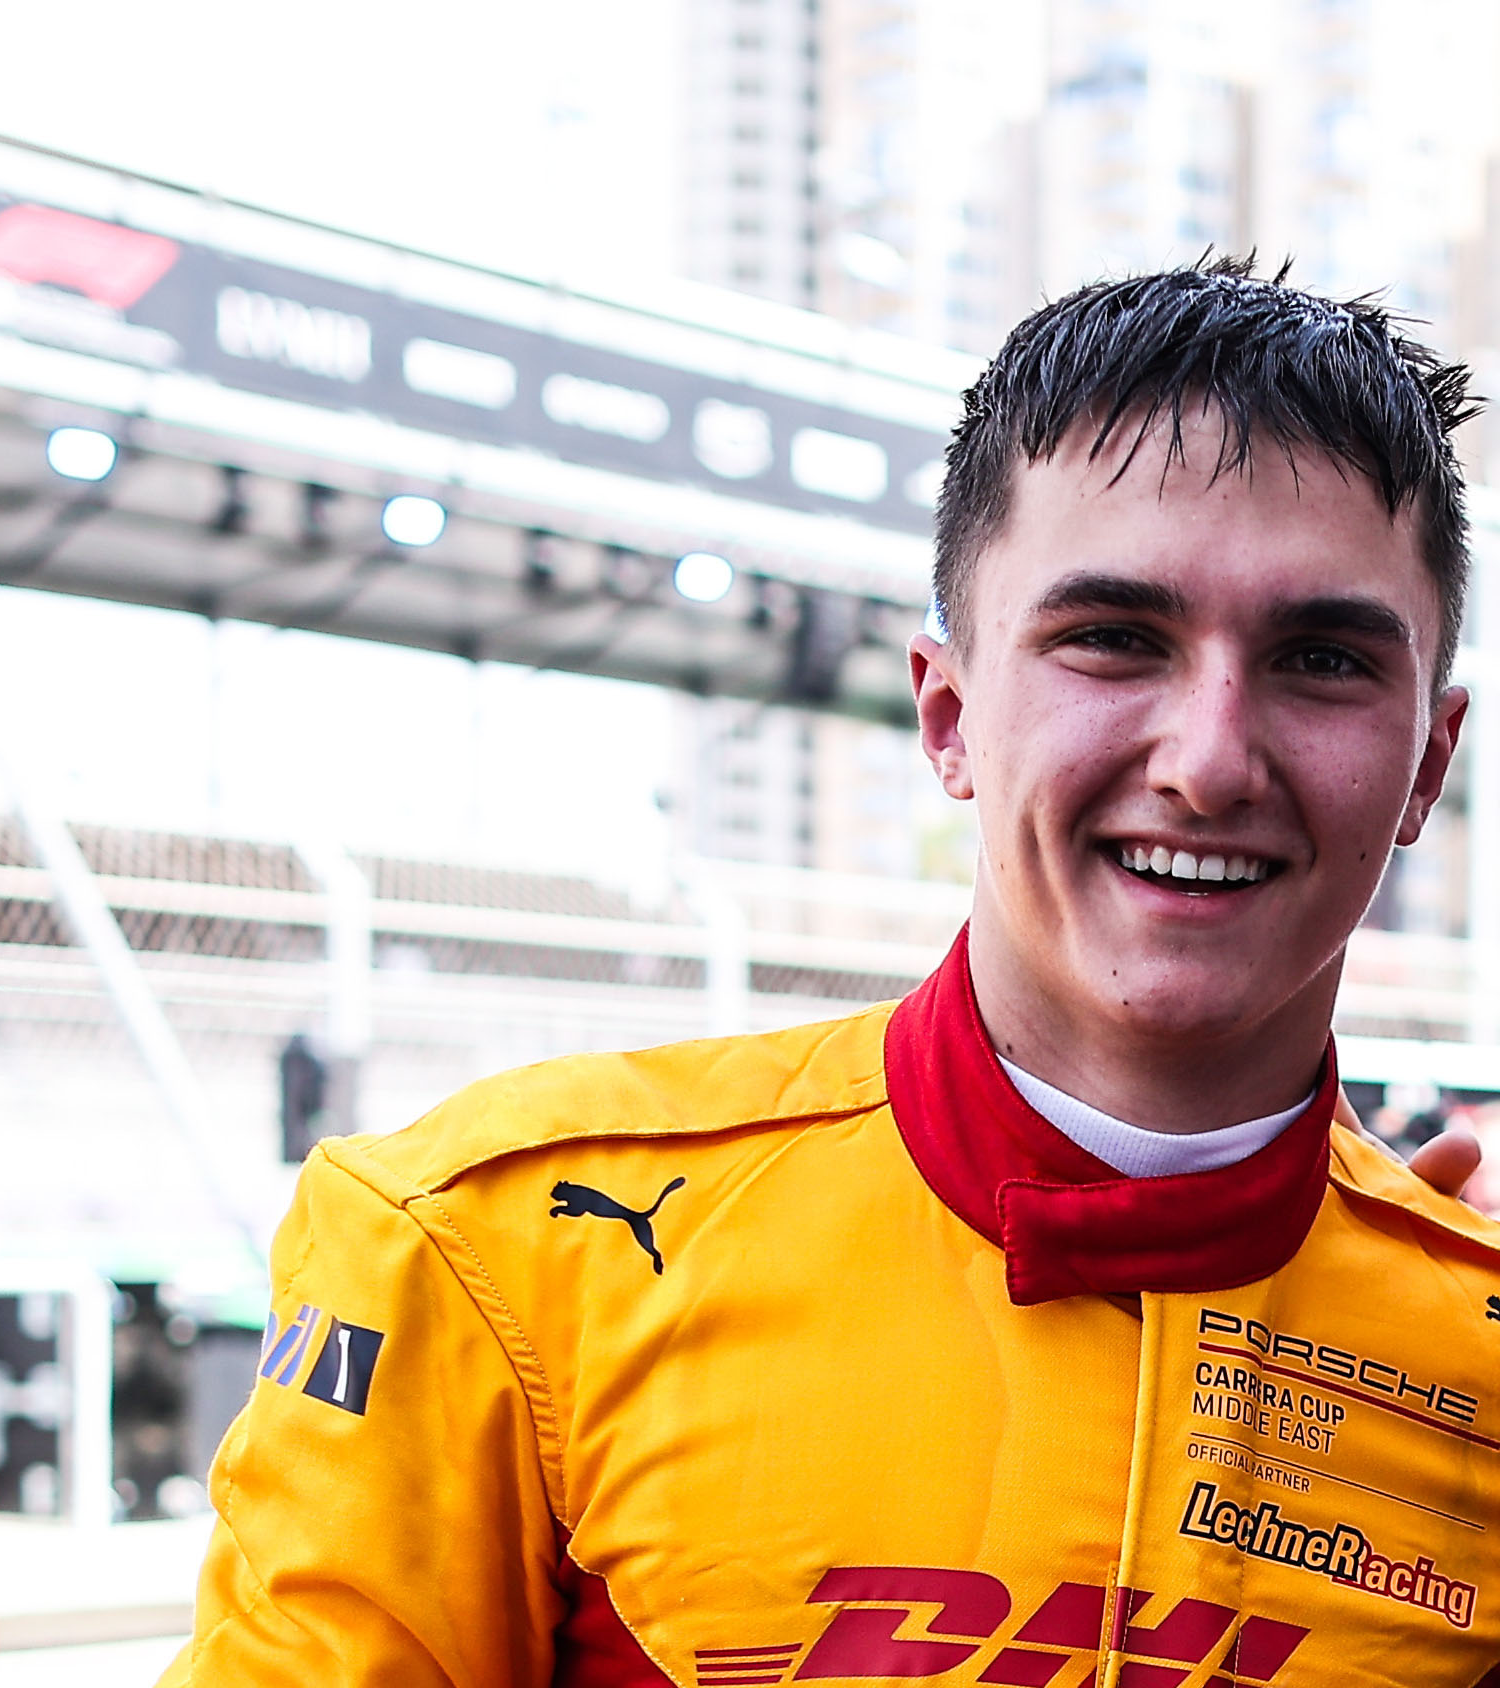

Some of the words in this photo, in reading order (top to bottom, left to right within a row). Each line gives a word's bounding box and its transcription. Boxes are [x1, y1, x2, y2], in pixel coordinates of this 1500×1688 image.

[1196, 1362, 1294, 1412] CARRERA
[1300, 1394, 1345, 1426] CUP
[1199, 1308, 1478, 1423] PORSCHE
[1193, 1392, 1270, 1436] MIDDLE
[1278, 1416, 1336, 1454] EAST
[1188, 1442, 1250, 1474] OFFICIAL
